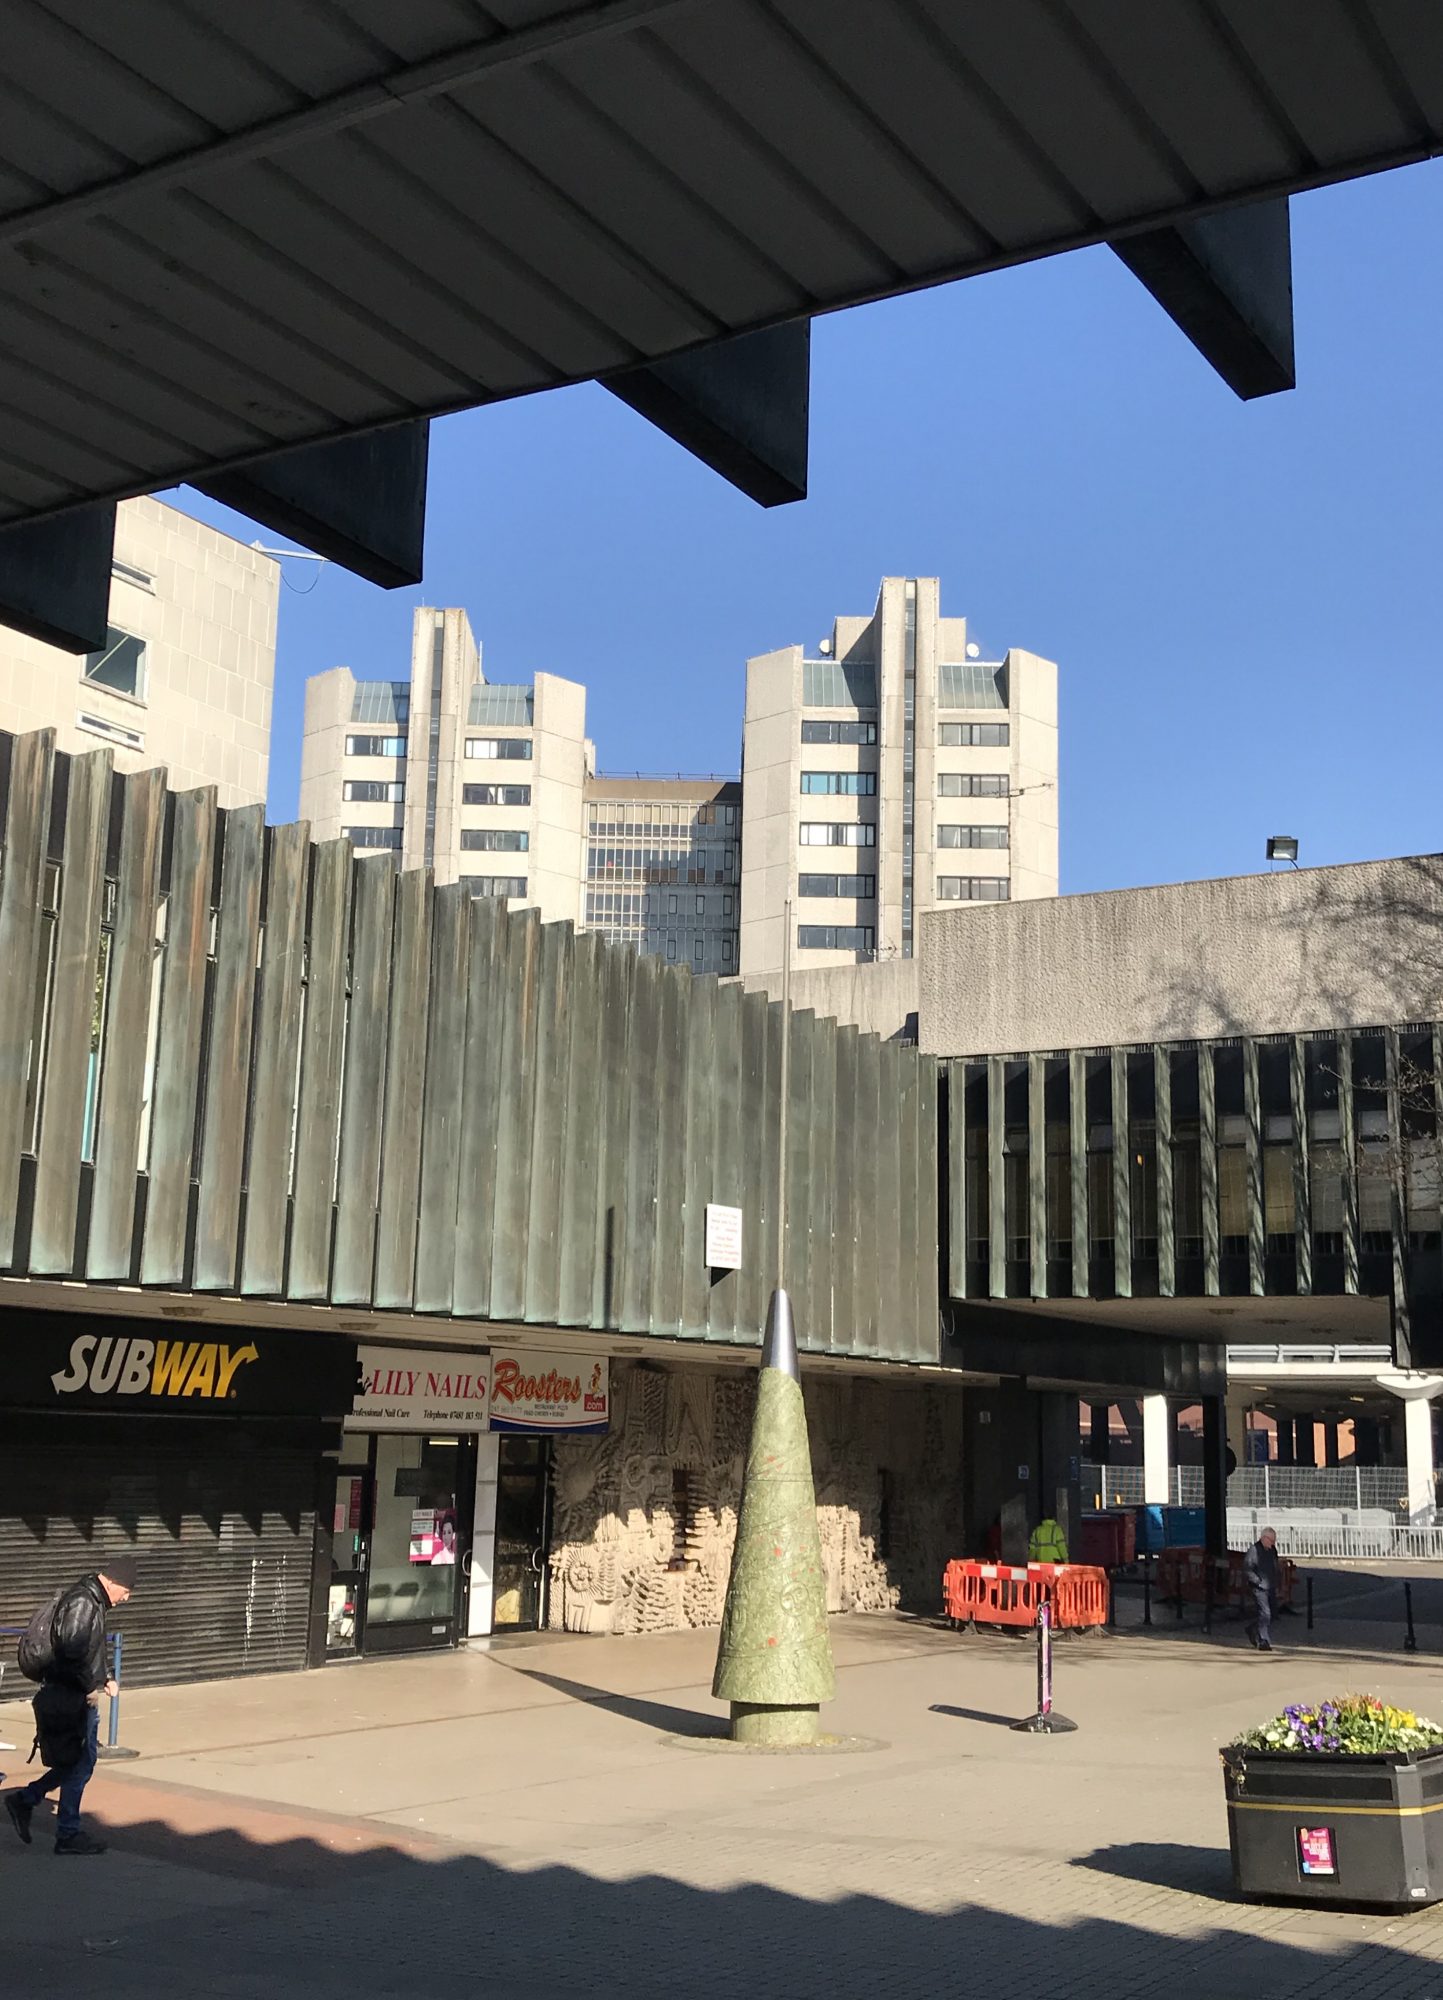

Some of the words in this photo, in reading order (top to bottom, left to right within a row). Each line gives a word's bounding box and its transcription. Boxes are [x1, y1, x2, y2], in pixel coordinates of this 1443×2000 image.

[51, 1335, 258, 1397] SUBWAY
[491, 1358, 581, 1404] Roosters
[370, 1369, 421, 1396] LILY
[424, 1372, 487, 1400] NAILS
[352, 1407, 383, 1417] rofessional
[384, 1408, 396, 1418] Nail
[397, 1409, 410, 1418] Care
[424, 1409, 448, 1421] Telephone
